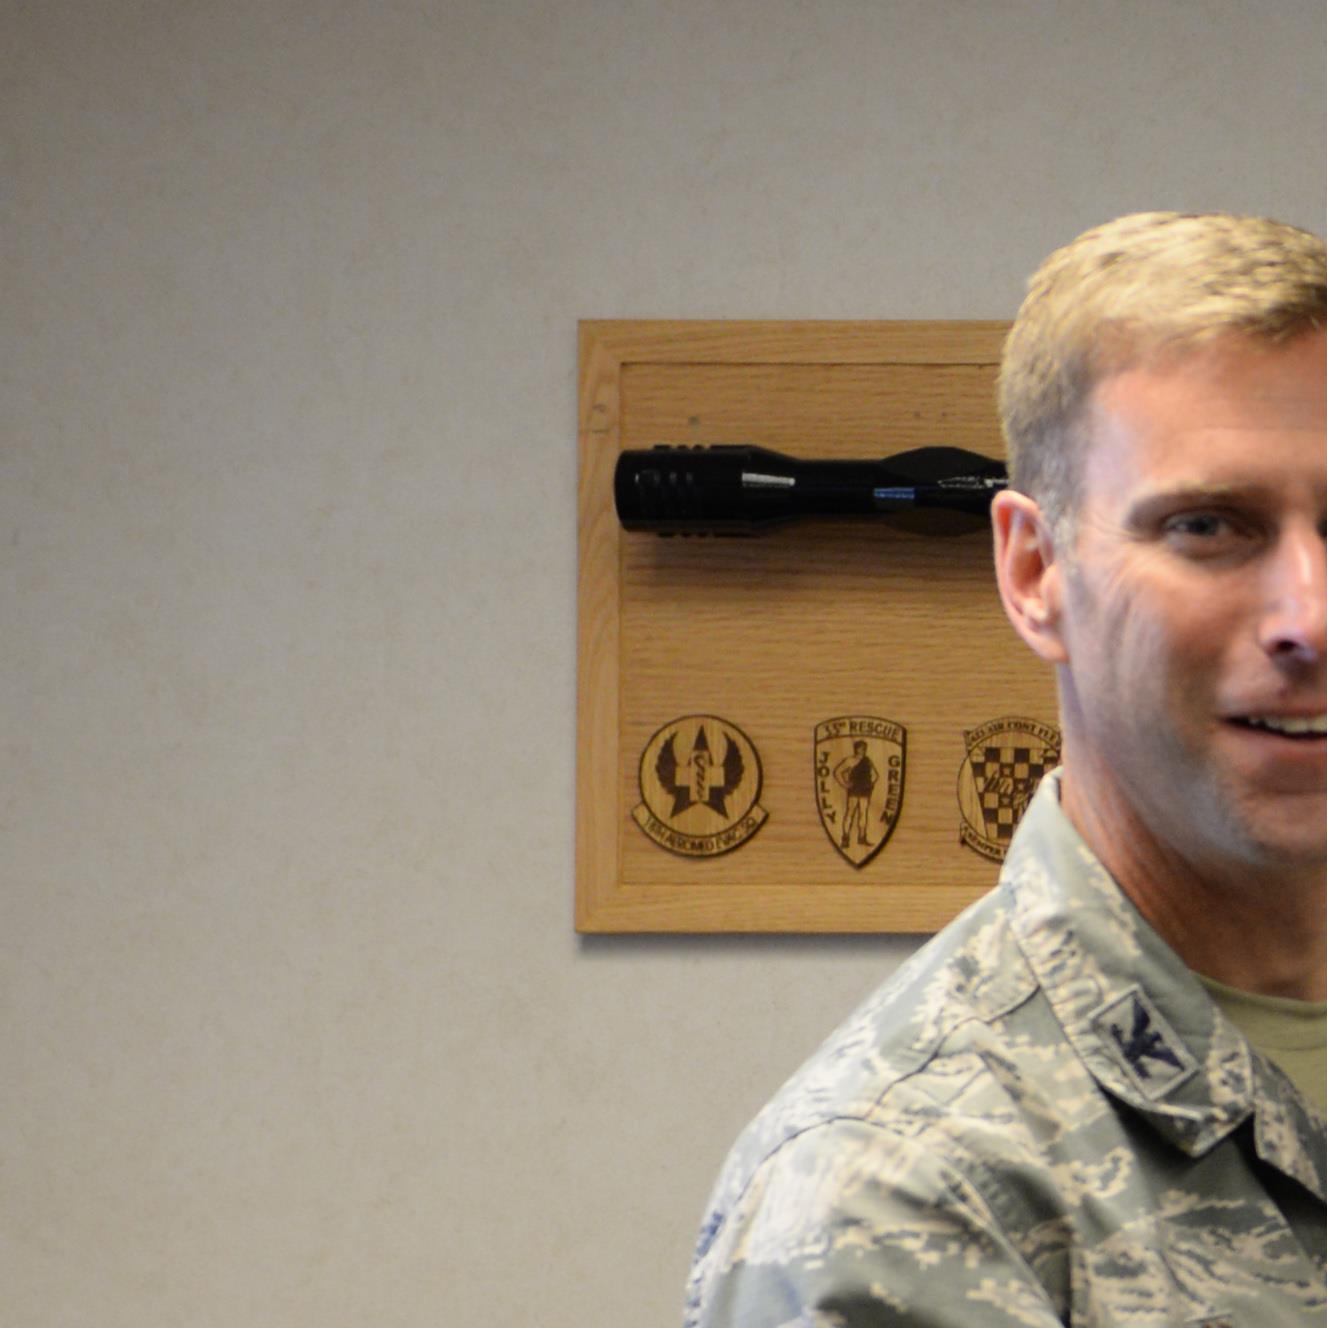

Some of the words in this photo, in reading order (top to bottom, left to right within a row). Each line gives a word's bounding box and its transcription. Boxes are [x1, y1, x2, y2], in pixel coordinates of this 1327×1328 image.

[849, 720, 899, 741] RESCUE
[817, 751, 836, 824] JOLLY
[880, 754, 901, 825] GREEN
